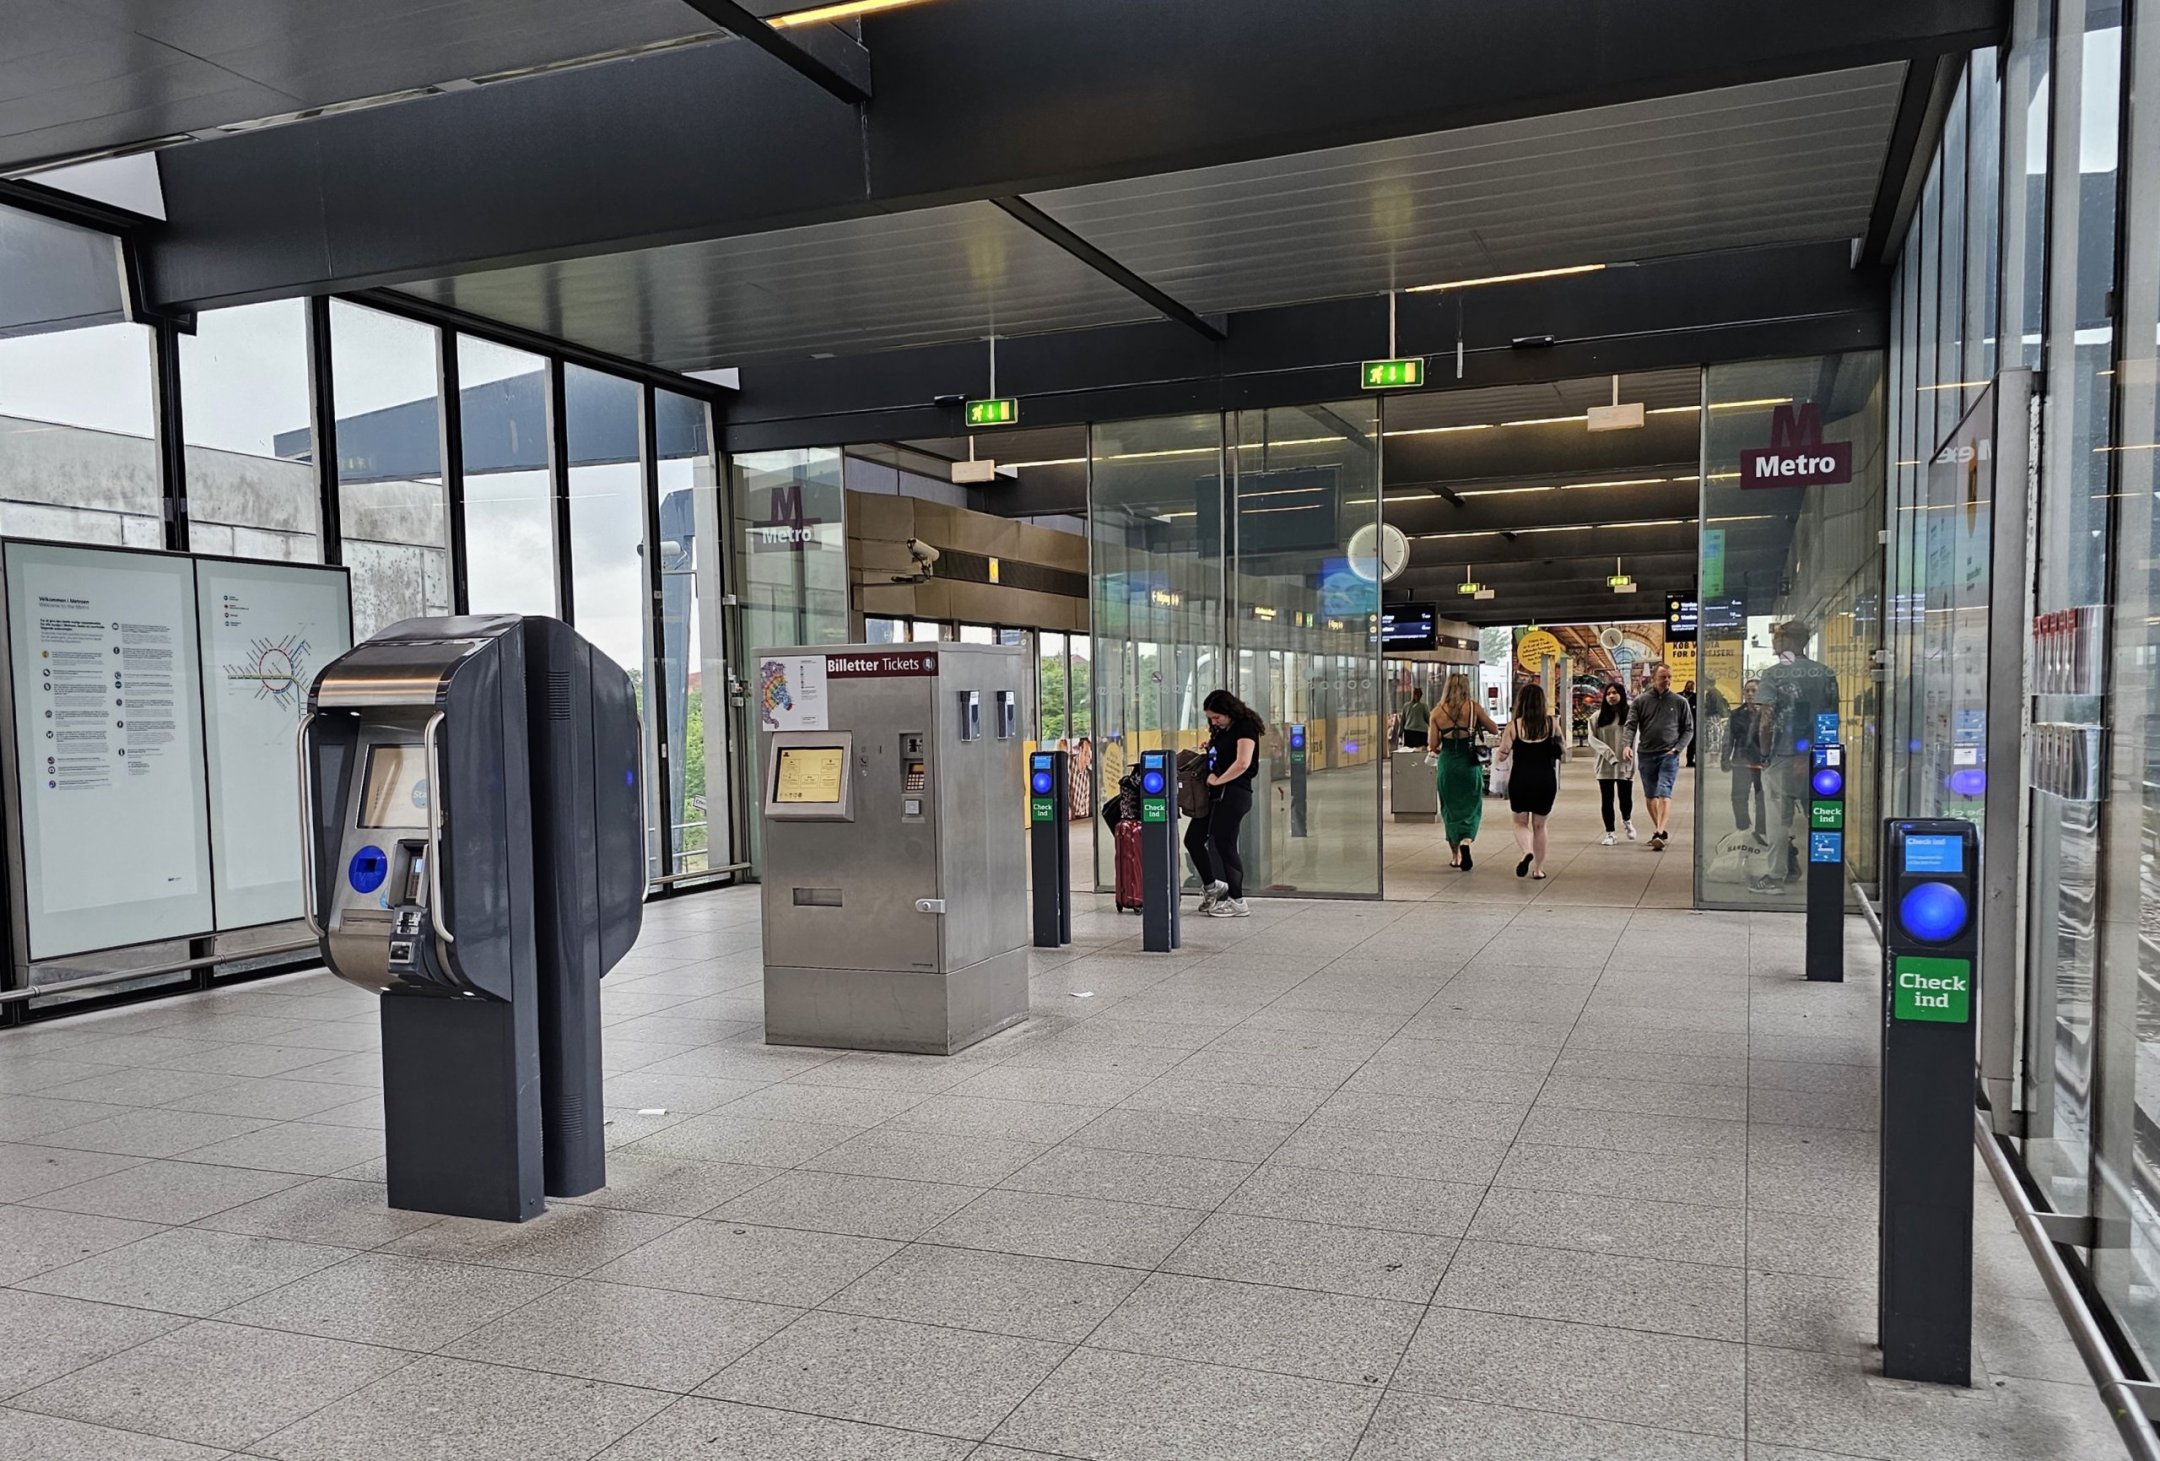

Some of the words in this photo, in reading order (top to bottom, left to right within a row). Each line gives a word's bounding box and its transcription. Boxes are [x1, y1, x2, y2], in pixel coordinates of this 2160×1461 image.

[1755, 454, 1836, 478] Metro
[762, 527, 812, 544] Metro
[827, 658, 879, 672] Billetter
[882, 657, 919, 671] Tickets
[1813, 807, 1842, 815] Check
[1819, 815, 1835, 823] ind
[1899, 973, 1967, 991] Check
[1914, 991, 1949, 1008] ind
